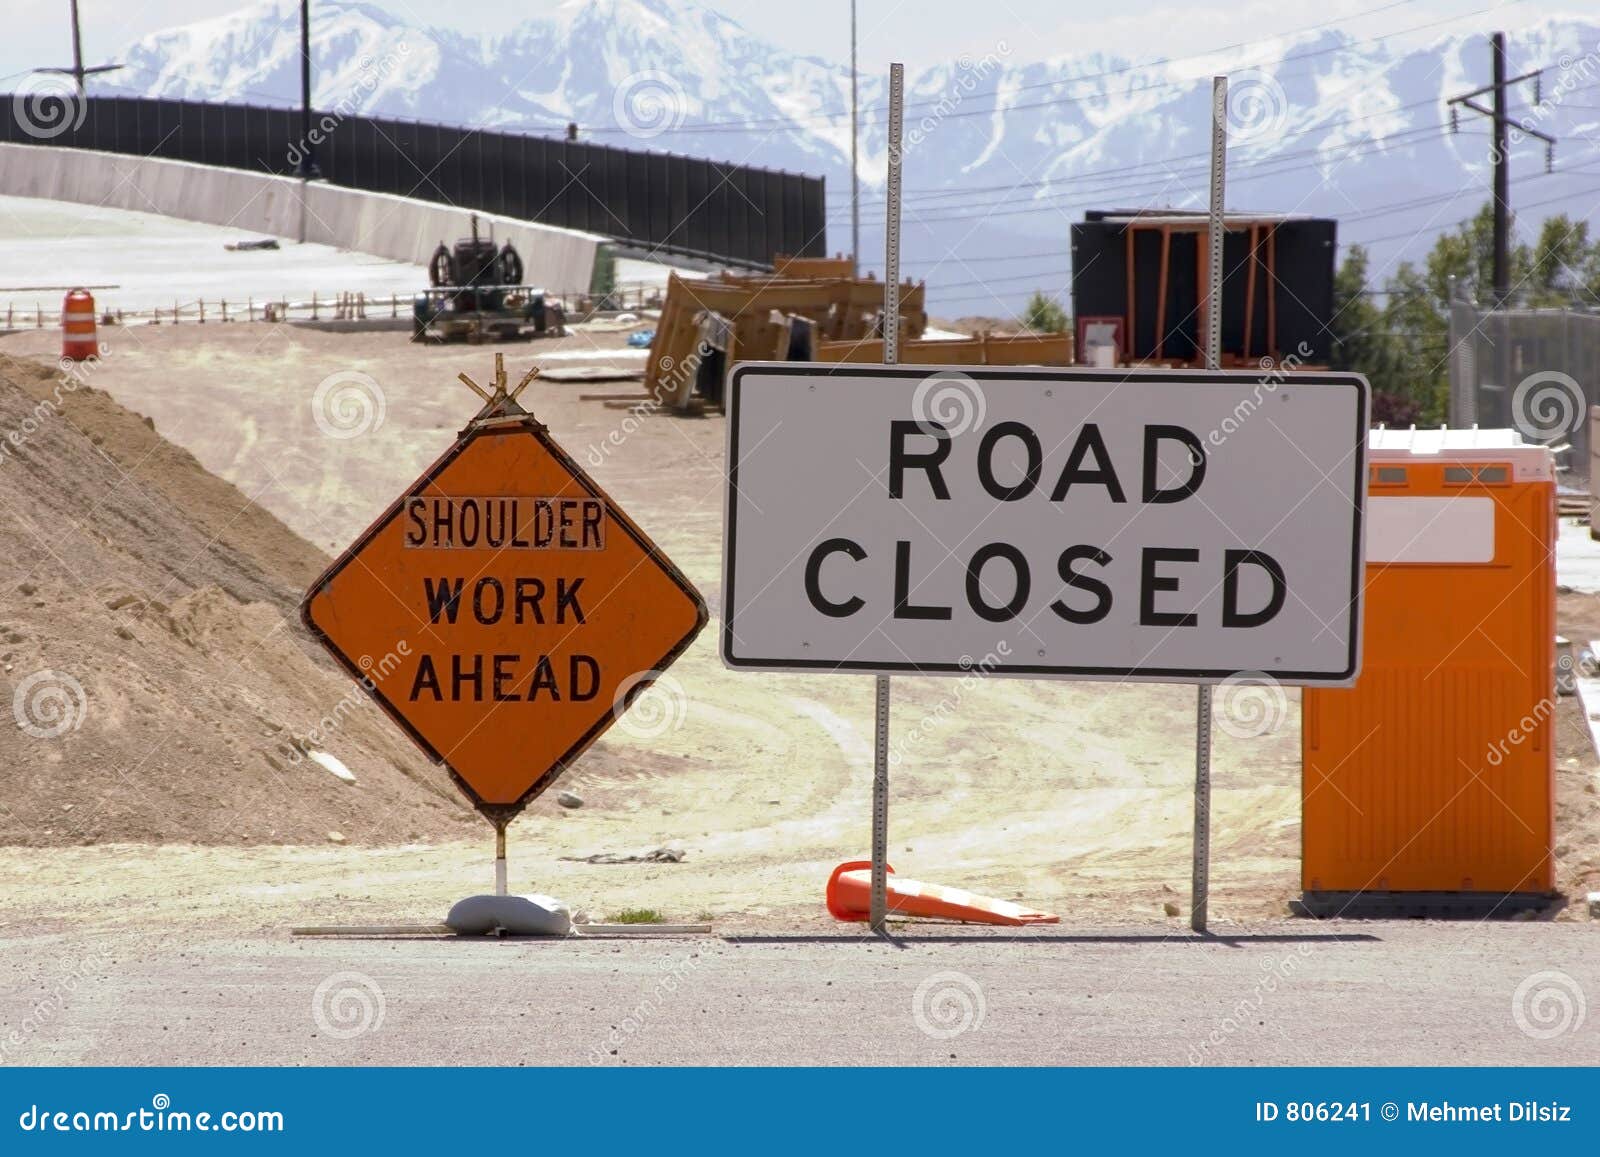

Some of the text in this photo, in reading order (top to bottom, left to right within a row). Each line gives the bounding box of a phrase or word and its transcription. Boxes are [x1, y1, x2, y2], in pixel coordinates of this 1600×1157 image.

[888, 421, 1207, 504] ROAD
[407, 498, 603, 548] SHOULDER
[424, 577, 586, 625] WORK
[804, 538, 1287, 629] CLOSED
[409, 654, 601, 702] AHEAD
